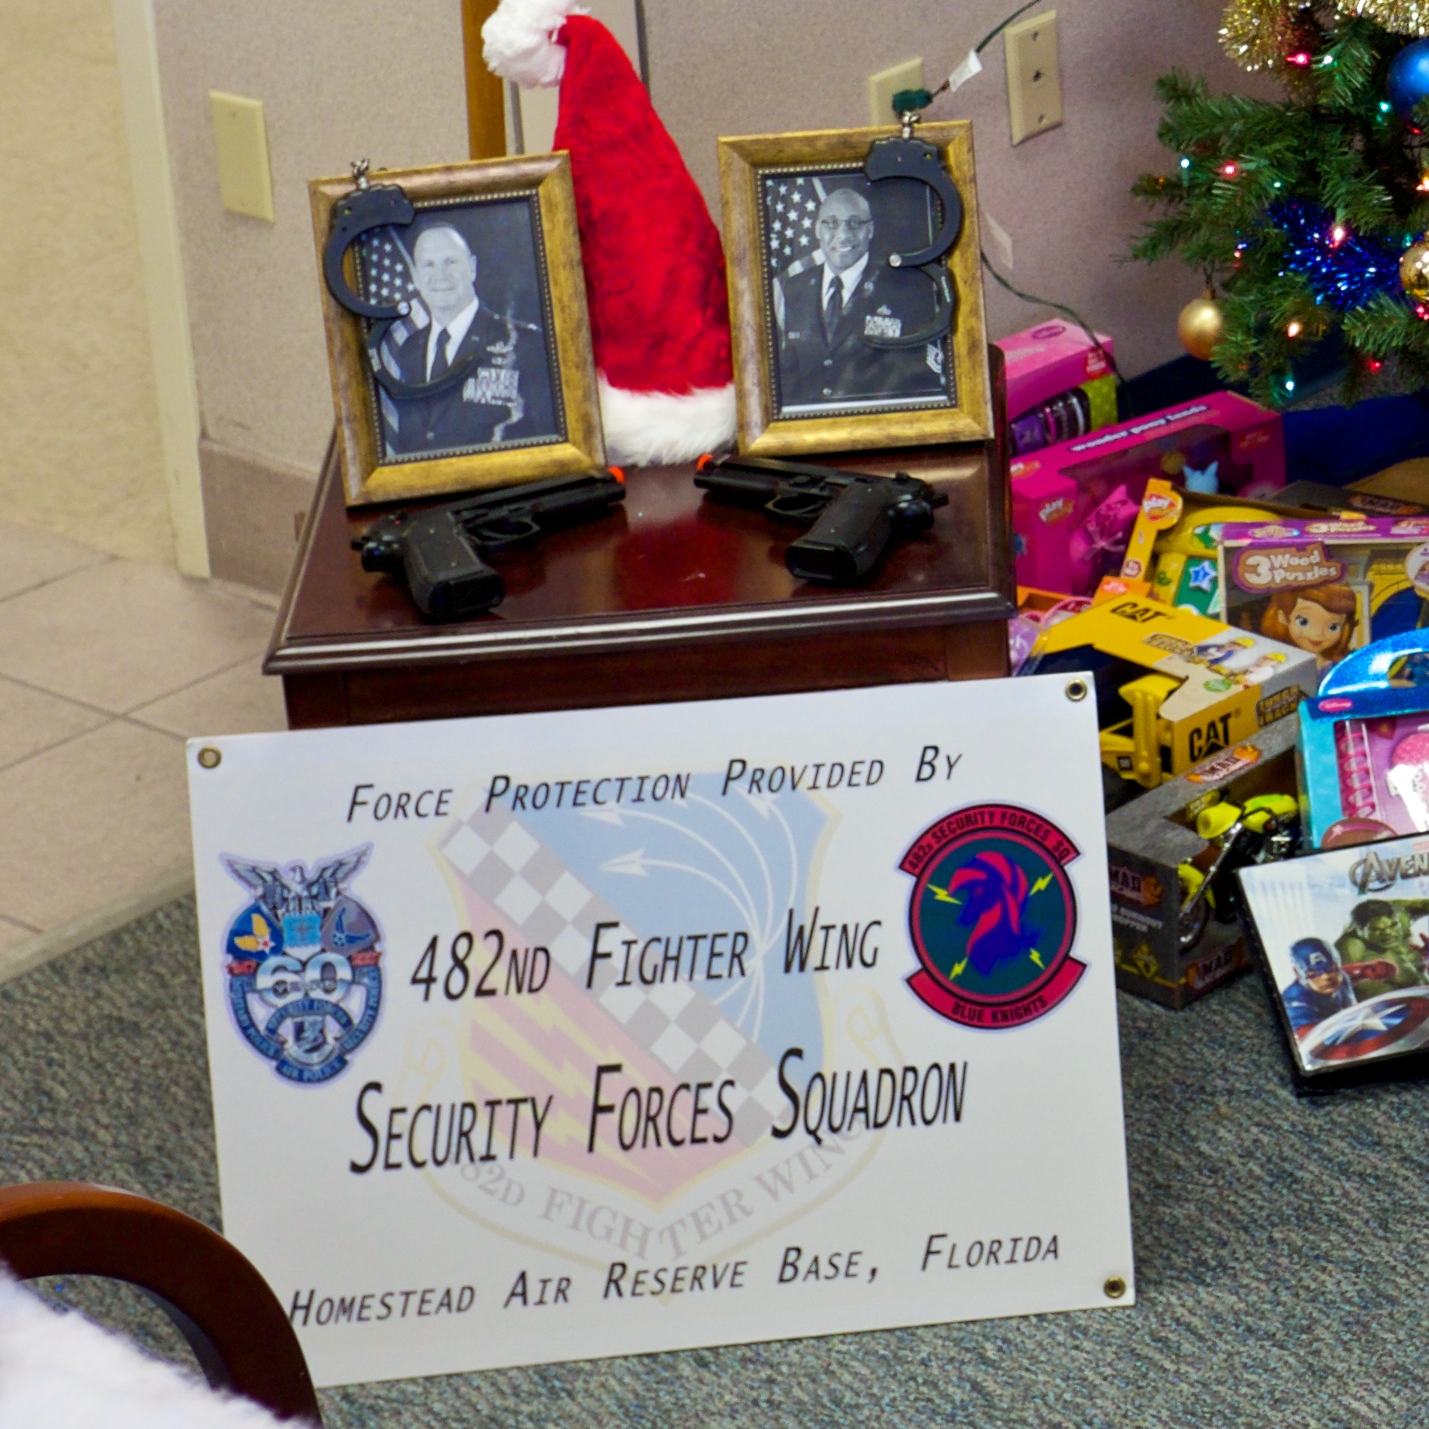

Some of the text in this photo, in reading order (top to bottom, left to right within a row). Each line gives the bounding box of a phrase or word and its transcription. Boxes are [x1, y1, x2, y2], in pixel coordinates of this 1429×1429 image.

[1244, 554, 1273, 585] 3
[1270, 550, 1320, 568] Wood
[1273, 565, 1338, 584] Puzzles
[1110, 601, 1161, 623] CAT
[1189, 713, 1232, 764] CAT
[345, 743, 965, 824] FORCE PROTECTION PROVIDED BY
[931, 809, 998, 846] SECURITY
[1001, 810, 1051, 841] FORCES
[1051, 841, 1072, 861] SQ
[410, 906, 884, 1002] 482ND FIGHTER WING
[951, 994, 1049, 1023] BLUE KNIGHTS
[349, 1045, 968, 1173] SECURITY FORCES SQUADRON
[538, 1185, 754, 1262] FIGHTER
[290, 1232, 1061, 1328] HOMESTEAD AIR RESERVE BASE, FLORIDA
